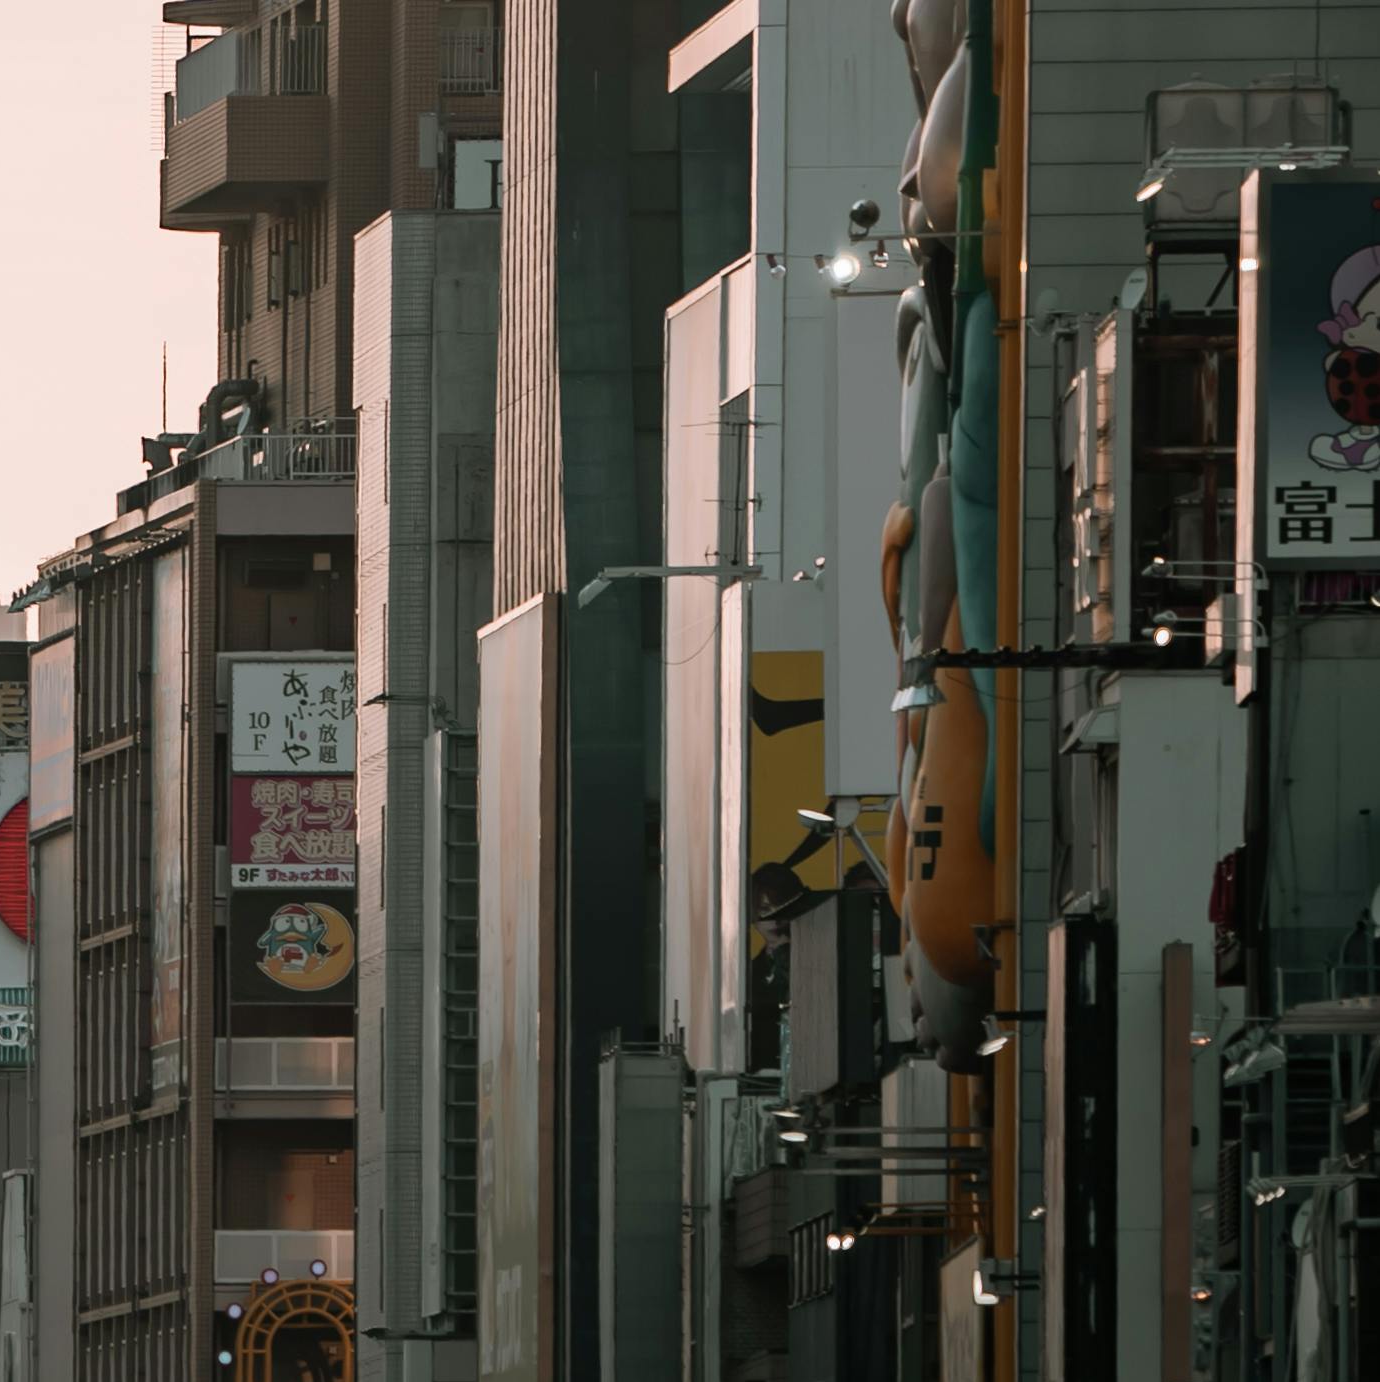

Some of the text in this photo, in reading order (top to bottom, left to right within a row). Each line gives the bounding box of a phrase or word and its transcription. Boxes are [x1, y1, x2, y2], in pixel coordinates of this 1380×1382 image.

[248, 712, 271, 730] 10
[318, 685, 339, 764] 食べ放題
[253, 733, 267, 751] F
[260, 806, 354, 832] スイーツ
[250, 829, 355, 863] 食べ放題
[238, 867, 260, 883] 9F
[265, 867, 340, 883] すたみな太郎
